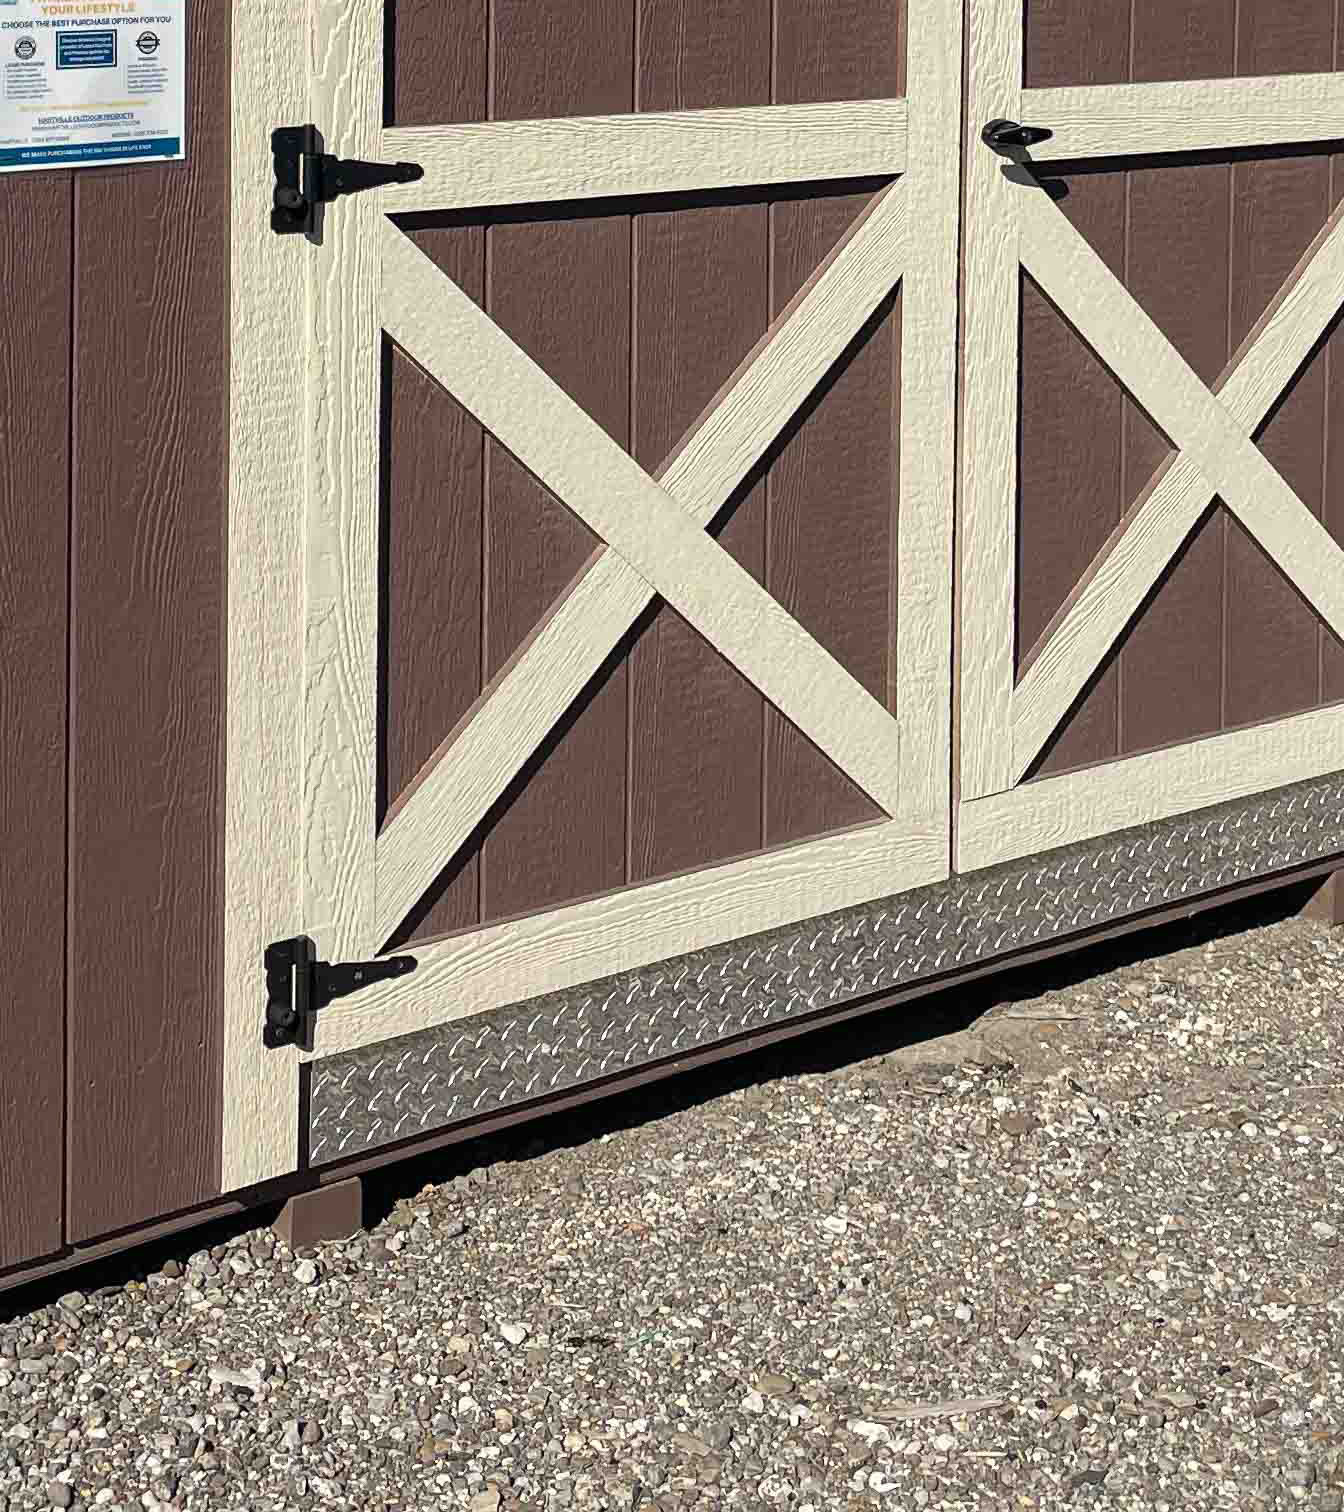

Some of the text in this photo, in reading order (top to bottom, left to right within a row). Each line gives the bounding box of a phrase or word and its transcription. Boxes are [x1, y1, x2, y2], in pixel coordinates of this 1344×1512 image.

[42, 2, 136, 15] YOUR LIFESTYLE
[1, 21, 34, 29] CHOOSE
[51, 18, 70, 27] BEST
[71, 18, 111, 27] PURCHASE
[111, 17, 139, 25] OPTION
[156, 15, 172, 23] YOU
